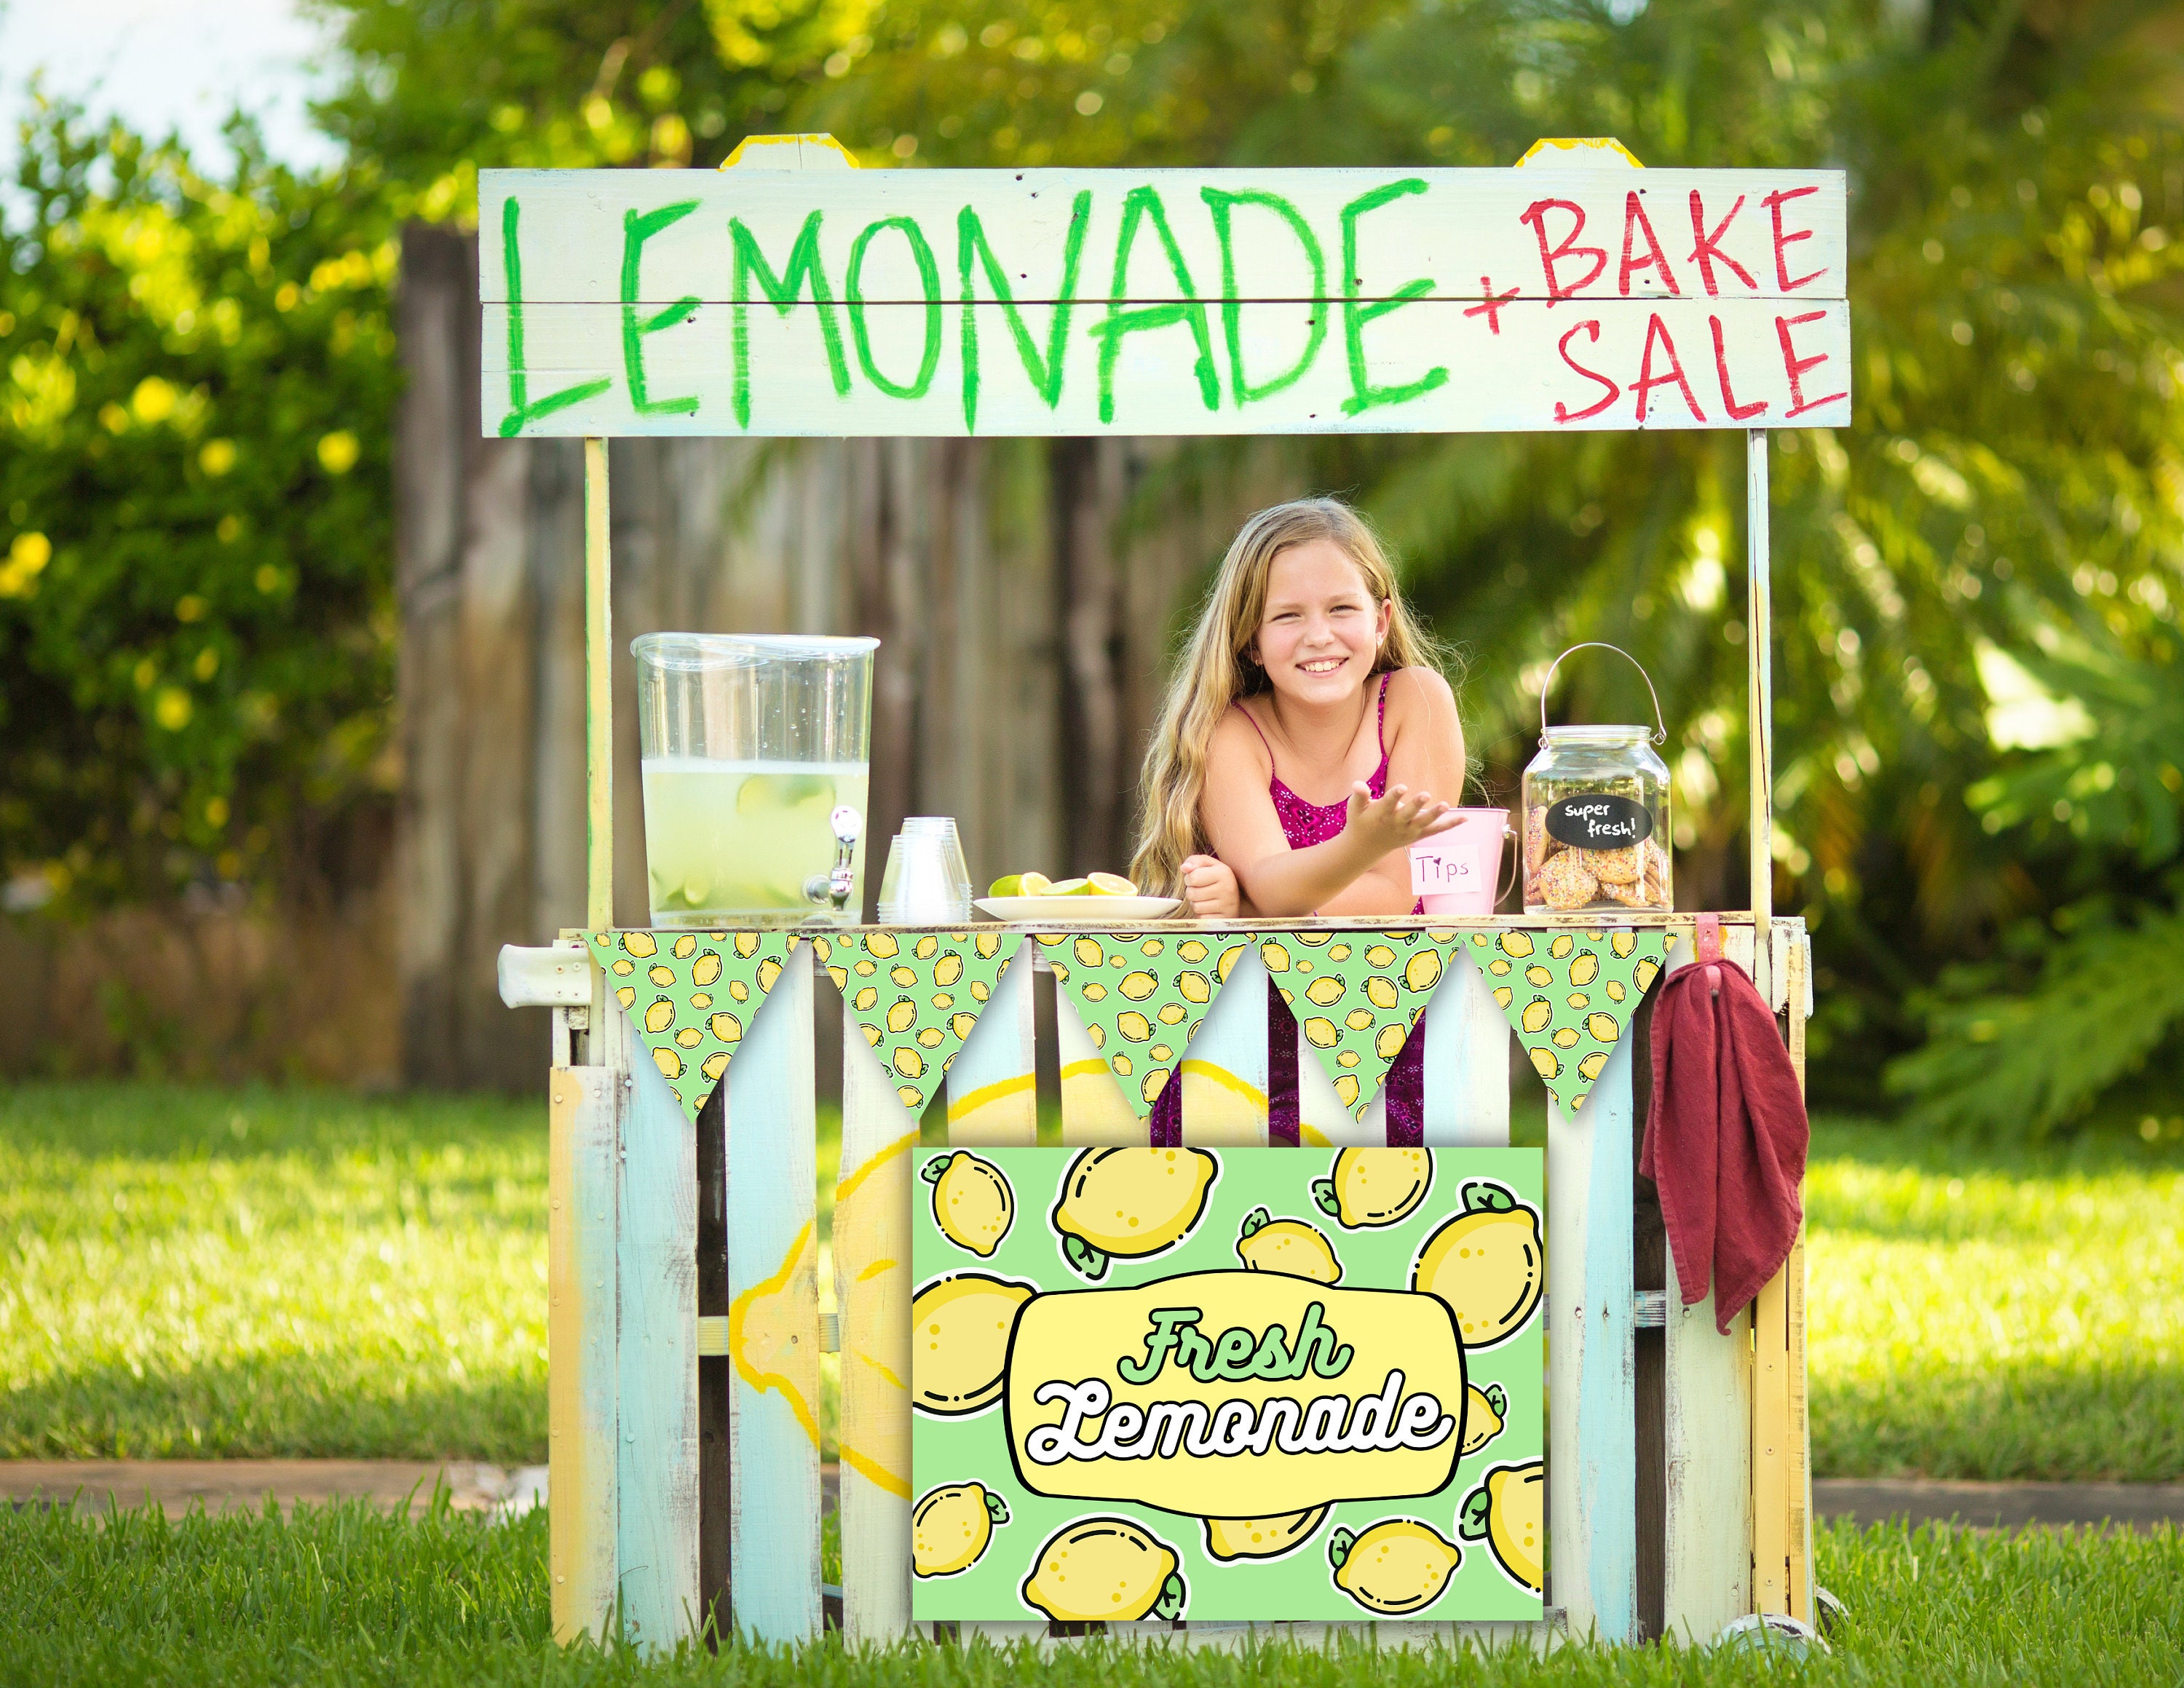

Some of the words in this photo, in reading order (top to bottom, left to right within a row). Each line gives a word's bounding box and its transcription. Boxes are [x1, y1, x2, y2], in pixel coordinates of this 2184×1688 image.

[499, 178, 1449, 438] LEMONADE
[1463, 276, 1521, 335] +
[1516, 186, 1829, 308] BAKE
[1554, 311, 1848, 424] SALE
[1564, 804, 1610, 821] super
[1588, 817, 1636, 839] fresh!
[1415, 855, 1469, 883] Tips
[1117, 1301, 1355, 1385] Fresh
[1024, 1368, 1455, 1466] Lemonade
